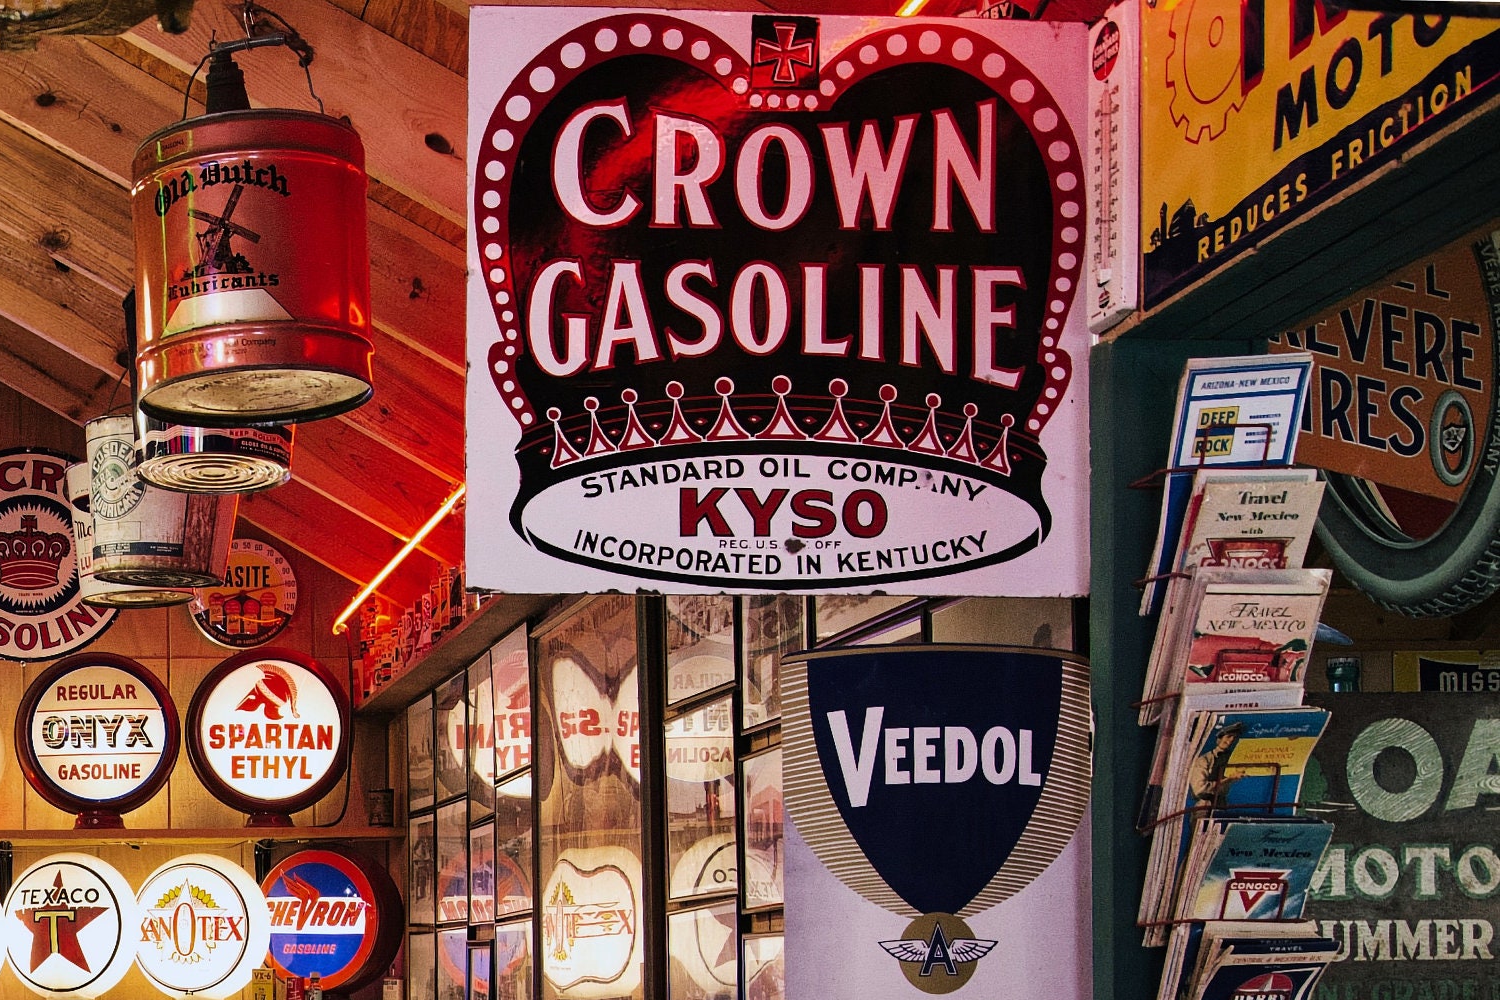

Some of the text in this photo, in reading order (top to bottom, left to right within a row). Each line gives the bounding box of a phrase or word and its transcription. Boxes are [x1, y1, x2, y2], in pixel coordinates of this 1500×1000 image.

[551, 97, 998, 234] CROWN
[1197, 172, 1307, 262] REDUCES
[1331, 65, 1472, 181] FRICTION
[154, 159, 292, 218] Old Dutch
[169, 271, 280, 302] Lubricants
[526, 257, 1027, 391] GASOLINE
[1200, 411, 1236, 425] DEEP
[581, 458, 746, 499] STANDARD
[759, 457, 811, 478] OIL
[1239, 490, 1288, 505] Travel
[679, 487, 889, 538] KYSO
[1216, 511, 1299, 522] New Mexico
[574, 529, 989, 576] INCORPORATED IN KENTUCKY
[223, 565, 271, 588] ASITE
[1229, 602, 1292, 618] TRAVEL
[1206, 619, 1306, 631] NEW MEXICO
[1221, 672, 1265, 682] CONOCO
[57, 684, 138, 701] REGULAR
[42, 714, 154, 750] ONYX
[209, 724, 333, 751] SPARTAN
[231, 755, 312, 780] ETHYL
[827, 706, 1042, 808] VEEDOL
[58, 763, 140, 780] GASOLINE
[21, 887, 99, 905] TEXACO
[1230, 882, 1278, 891] CONOCO
[33, 911, 75, 954] T
[283, 943, 337, 955] GASOLINE
